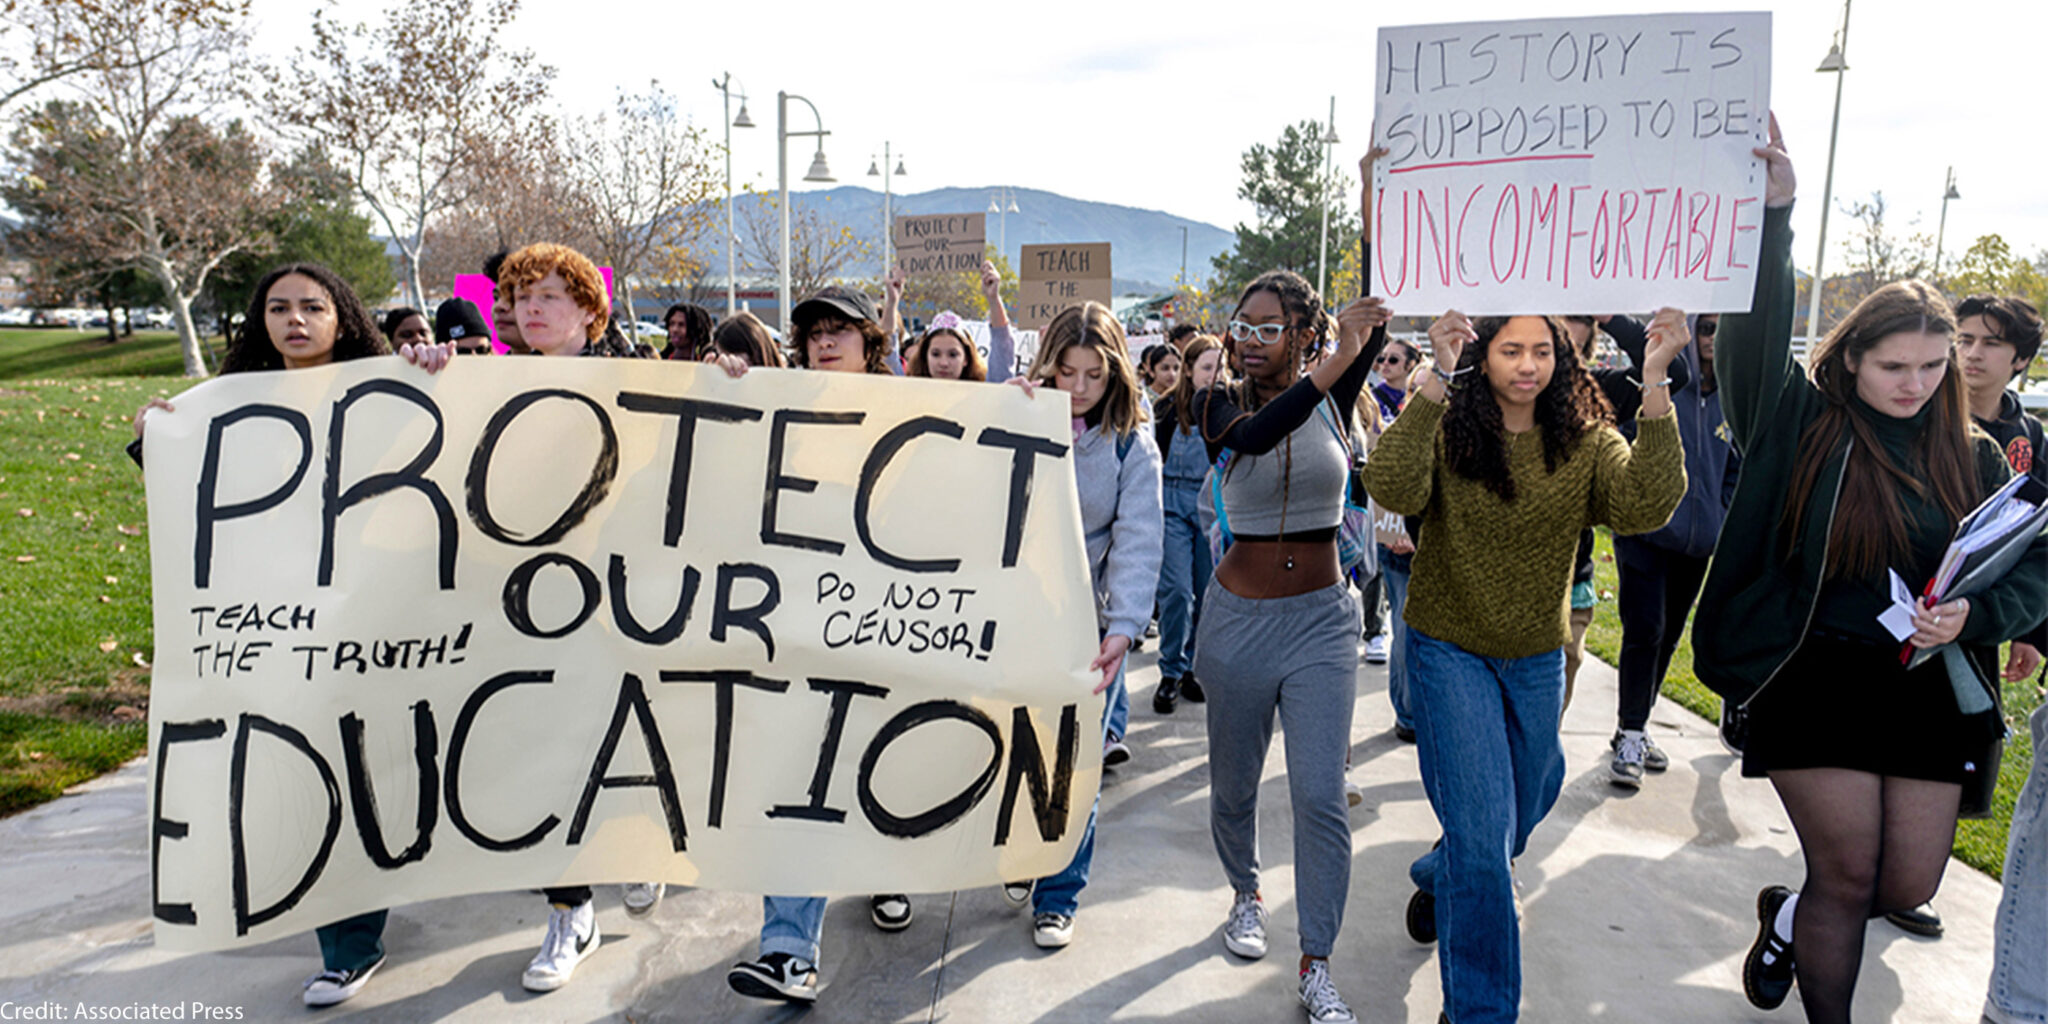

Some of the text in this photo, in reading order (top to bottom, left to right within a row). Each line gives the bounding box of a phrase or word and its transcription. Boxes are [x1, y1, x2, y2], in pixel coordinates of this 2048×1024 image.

[1385, 28, 1742, 94] HISTORY IS
[1386, 104, 1607, 167] SUPPOSED
[1622, 99, 1675, 139] TO
[904, 217, 969, 238] PROTECT
[924, 238, 950, 251] OUR
[1377, 183, 1758, 298] UNCOMFORTABLE
[900, 253, 982, 273] EDUCATION
[1036, 249, 1090, 272] TEACH
[1045, 281, 1079, 297] THE
[193, 378, 1070, 589] PROTECT
[190, 602, 316, 636] TEACH
[502, 552, 781, 662] OUR
[883, 581, 977, 613] NOT
[192, 622, 473, 680] THE TRUTH!
[823, 608, 997, 661] CENSOR!
[152, 668, 1081, 938] EDUCATION
